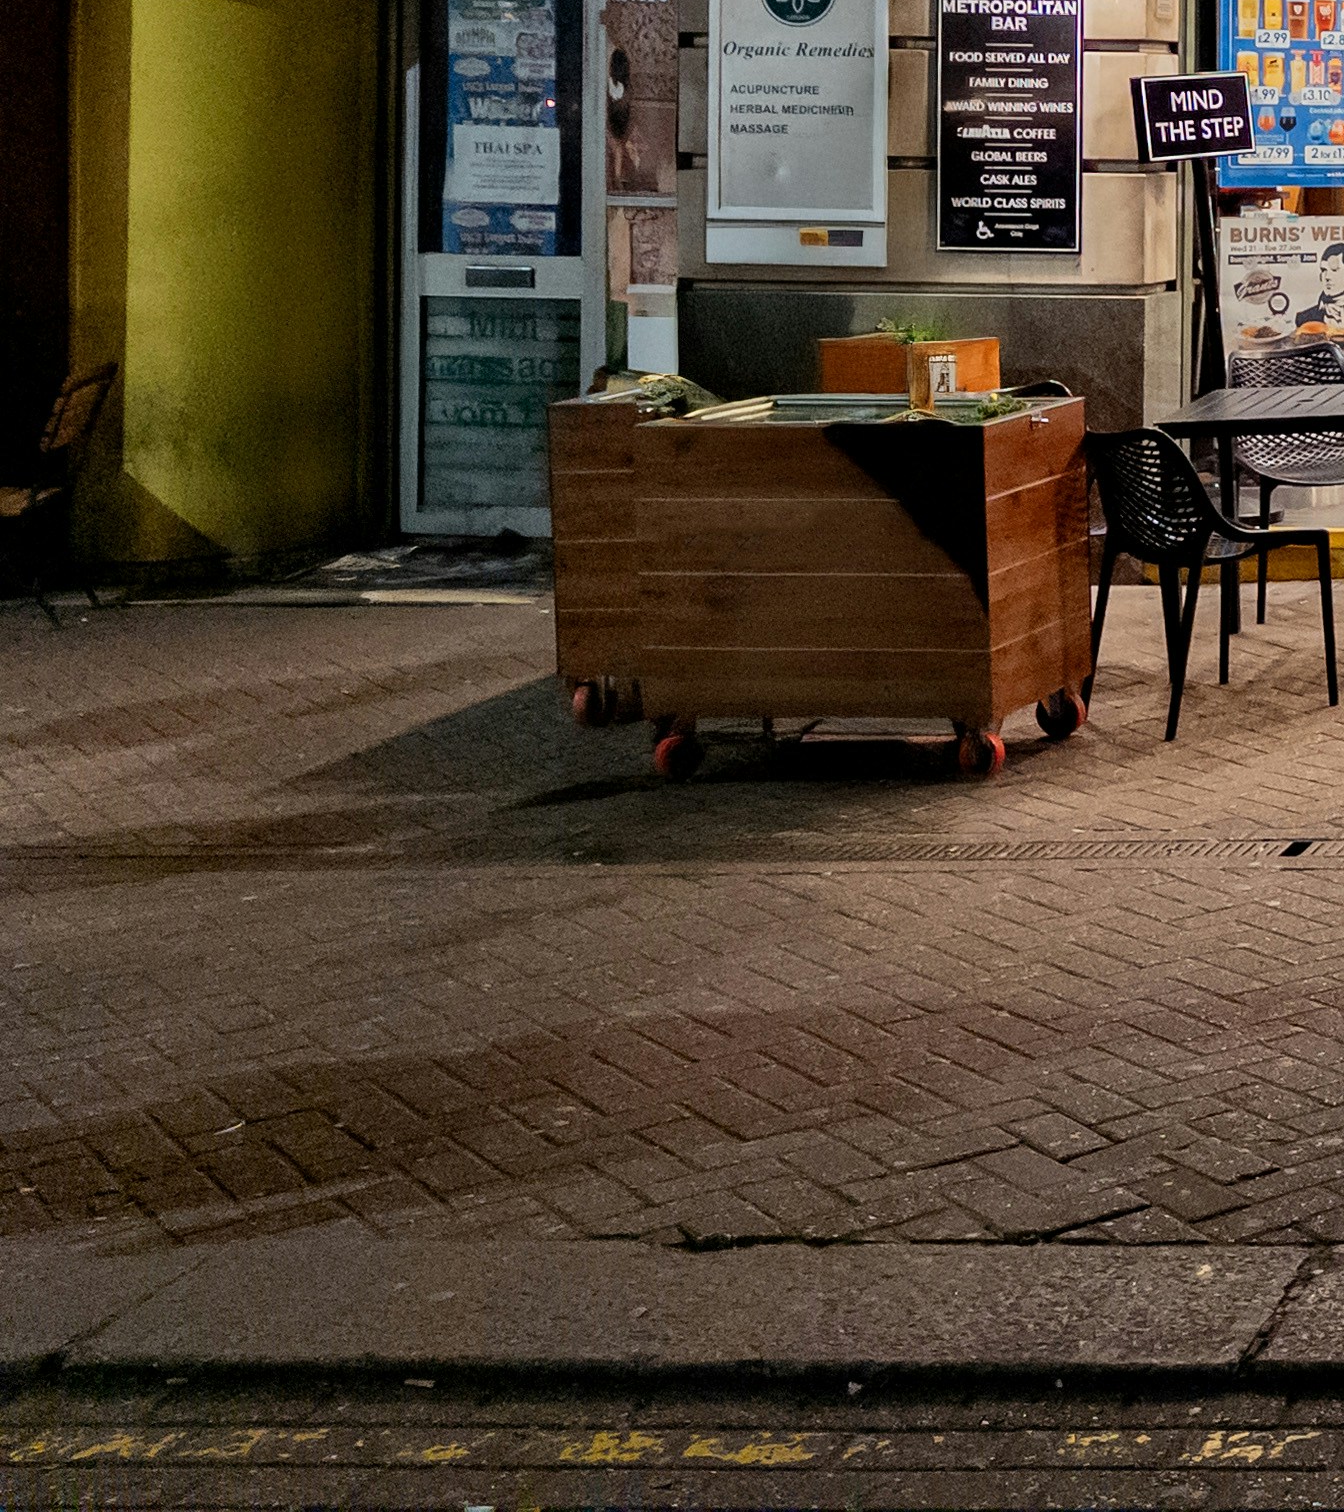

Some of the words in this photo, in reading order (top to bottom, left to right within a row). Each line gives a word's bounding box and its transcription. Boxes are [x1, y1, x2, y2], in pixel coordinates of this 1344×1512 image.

[942, 0, 1077, 15] METROPOLITAN
[990, 17, 1028, 32] BAR
[723, 41, 791, 59] Organic
[796, 42, 875, 59] Remedies
[949, 51, 982, 63] FOOD
[985, 51, 1026, 64] SERVED
[1027, 52, 1046, 64] ALL
[1048, 53, 1071, 64] DAY
[969, 76, 1006, 88] FAMILY
[1008, 77, 1049, 89] DINING
[730, 84, 820, 95] ACUPUNCTURE
[987, 101, 1037, 112] WINNING
[1039, 102, 1074, 113] WINES
[1170, 89, 1224, 112] MIND
[730, 104, 778, 114] HERBAL
[730, 124, 789, 134] MASSAGE
[1013, 128, 1057, 140] COFFEE
[1155, 120, 1197, 143] THE
[1201, 116, 1244, 139] STEP
[474, 141, 510, 155] THAI
[513, 142, 543, 155] SPA
[971, 150, 1012, 162] GLOBAL
[1015, 151, 1048, 162] BEERS
[980, 174, 1011, 185] CASK
[1011, 175, 1038, 185] ALES
[951, 197, 992, 208] WORLD
[994, 197, 1028, 208] CLASS
[1030, 198, 1066, 209] SPIRITS
[1230, 226, 1305, 243] BURNS'
